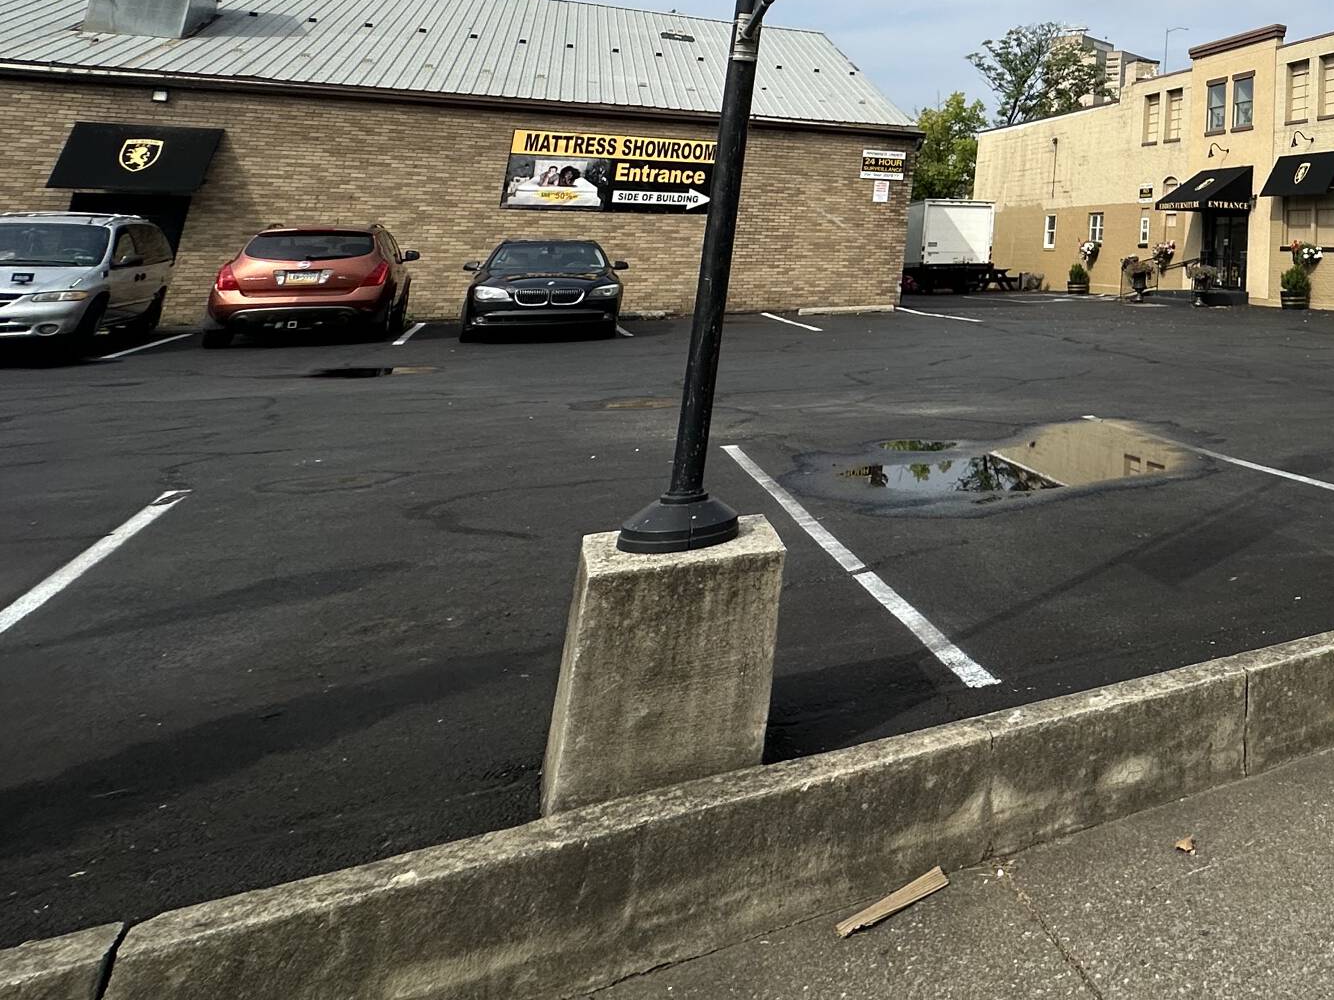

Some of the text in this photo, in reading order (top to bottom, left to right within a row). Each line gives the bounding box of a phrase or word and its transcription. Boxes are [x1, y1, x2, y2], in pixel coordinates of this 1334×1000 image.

[524, 133, 717, 161] MATTRESS SHOWROOM
[865, 157, 903, 167] 24 HOUR
[614, 163, 706, 184] Entrance
[618, 192, 699, 203] SIDE OF BUILDING
[1208, 201, 1249, 210] ENTRANCE
